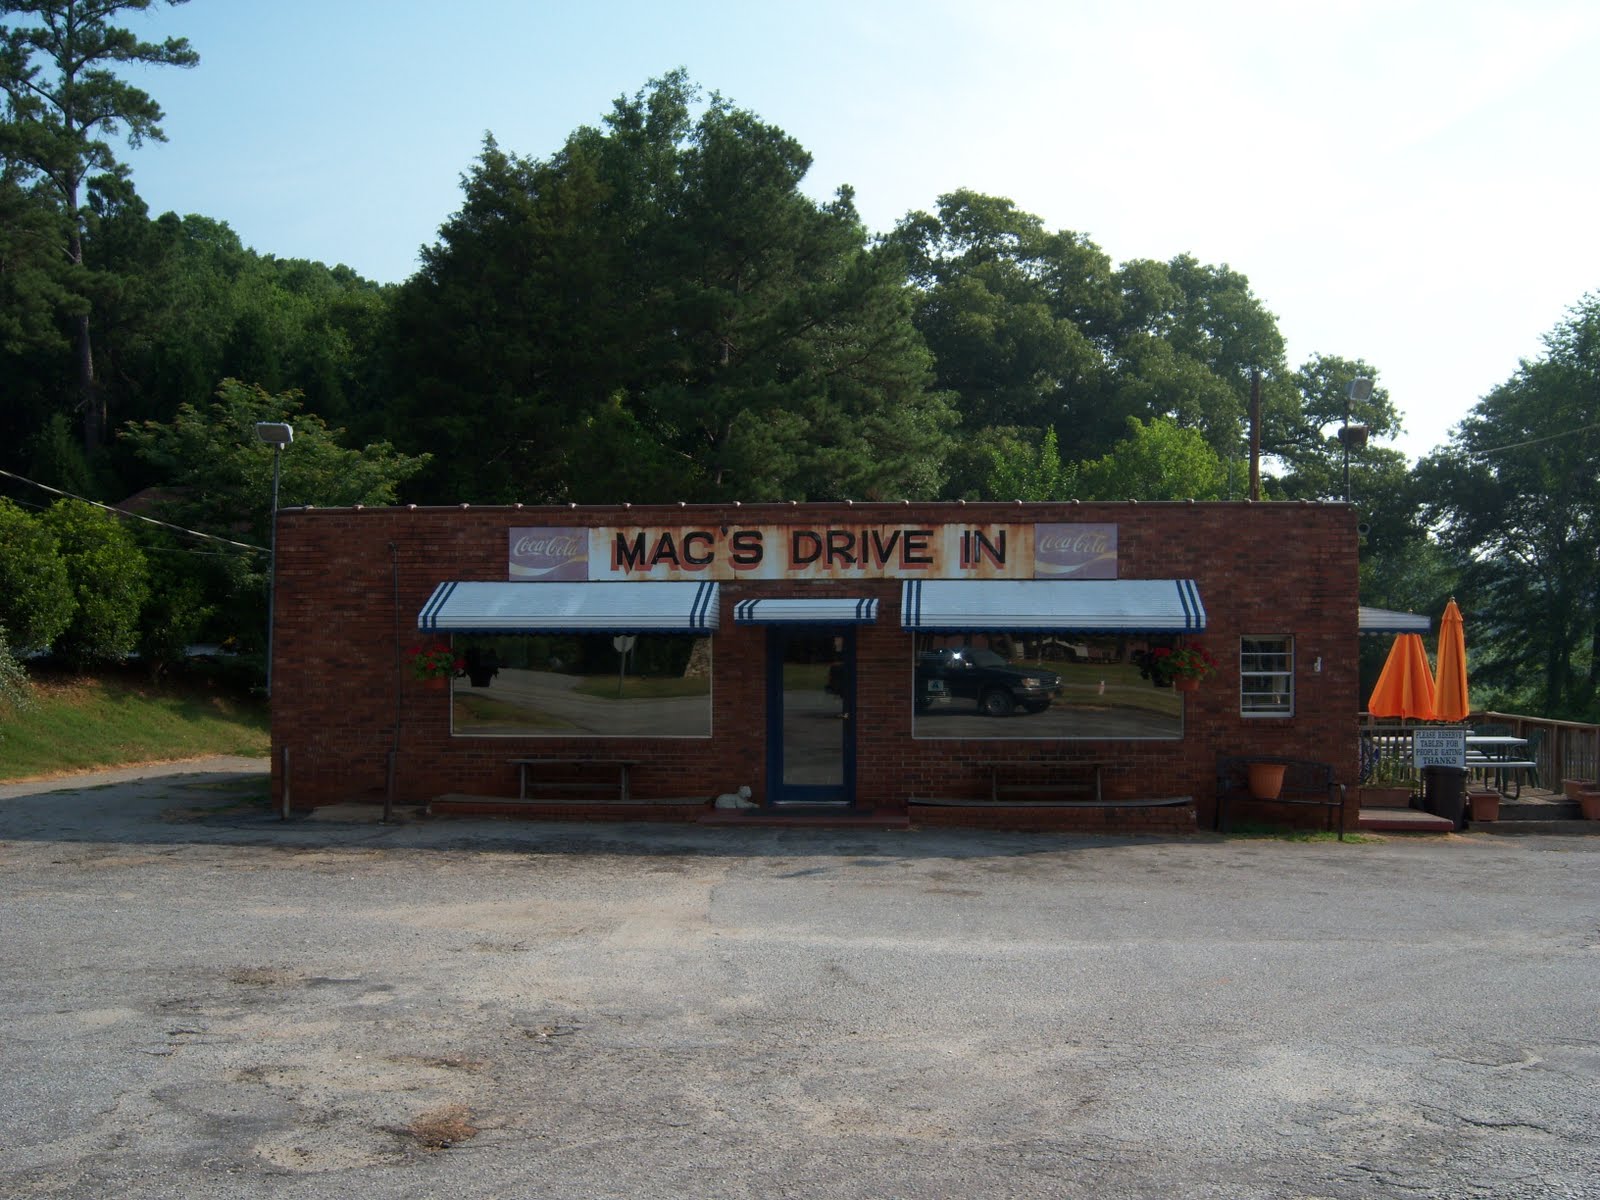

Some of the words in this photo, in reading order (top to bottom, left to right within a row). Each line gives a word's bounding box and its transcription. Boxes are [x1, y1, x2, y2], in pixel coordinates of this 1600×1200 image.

[513, 535, 579, 557] Coca-Cola
[611, 526, 763, 574] MAC'S
[788, 529, 935, 570] DRIVE
[961, 529, 1007, 570] IN
[1039, 531, 1104, 553] Coca-Cola
[1416, 731, 1436, 739] PLEASE
[1438, 731, 1462, 739] RESERVE
